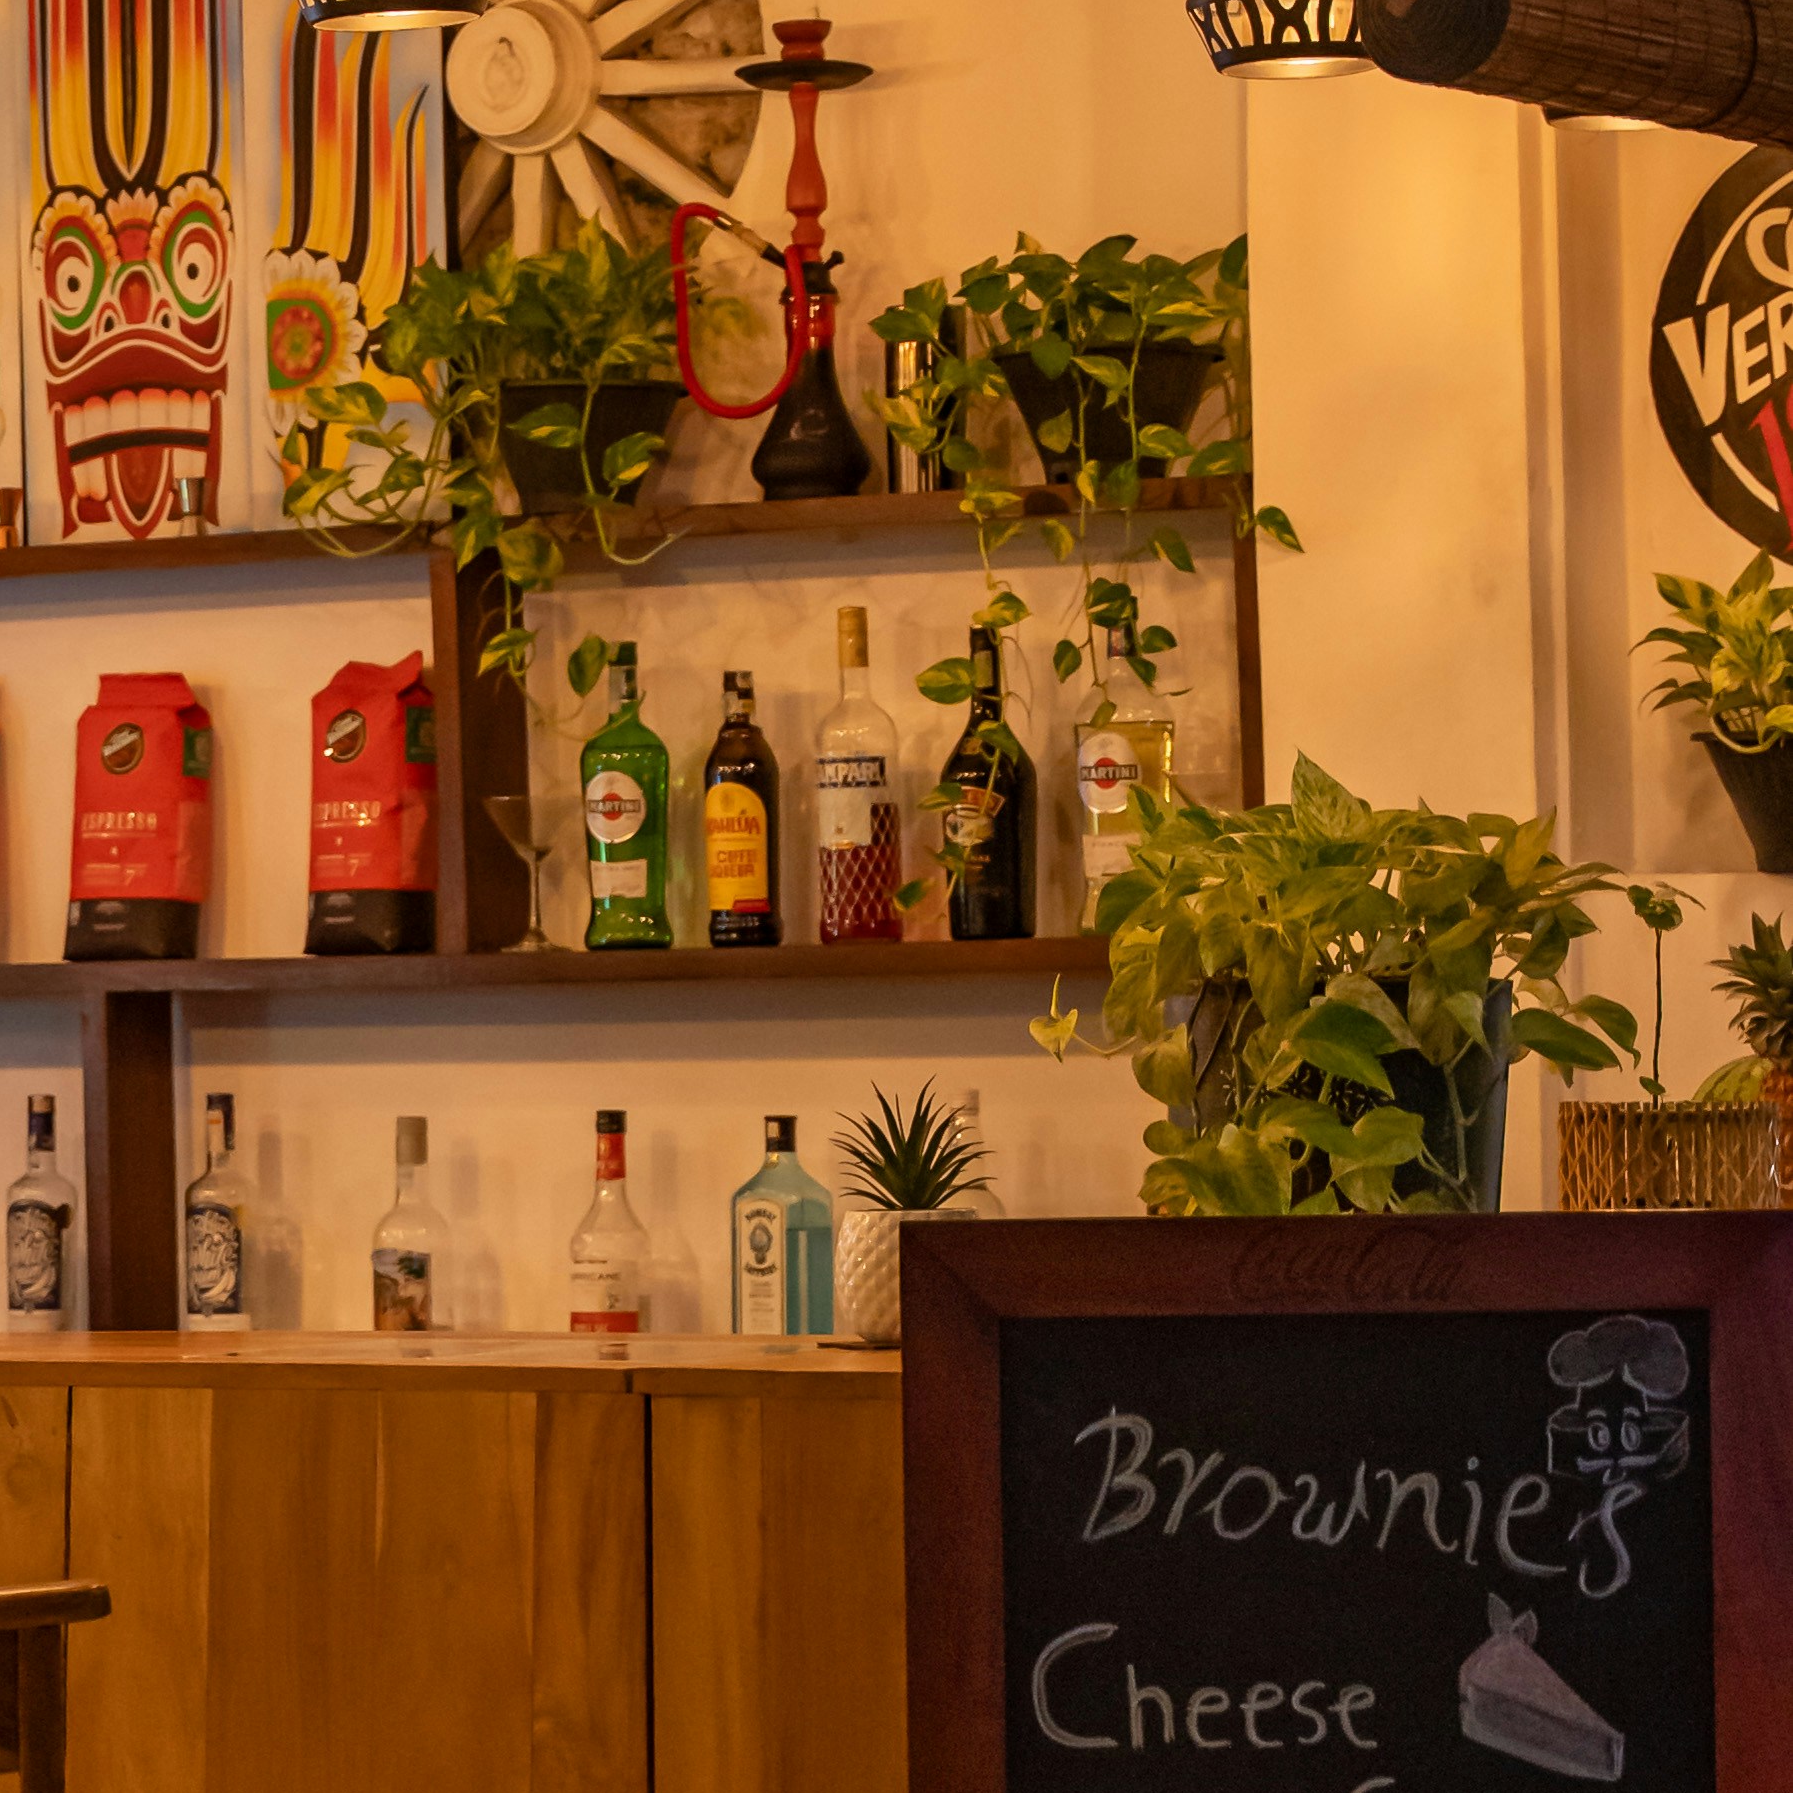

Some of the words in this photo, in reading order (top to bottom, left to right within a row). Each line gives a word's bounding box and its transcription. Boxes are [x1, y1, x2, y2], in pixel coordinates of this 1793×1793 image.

[1745, 207, 1793, 288] C
[1074, 1406, 1646, 1598] Brownies
[1032, 1623, 1379, 1751] Cheese
